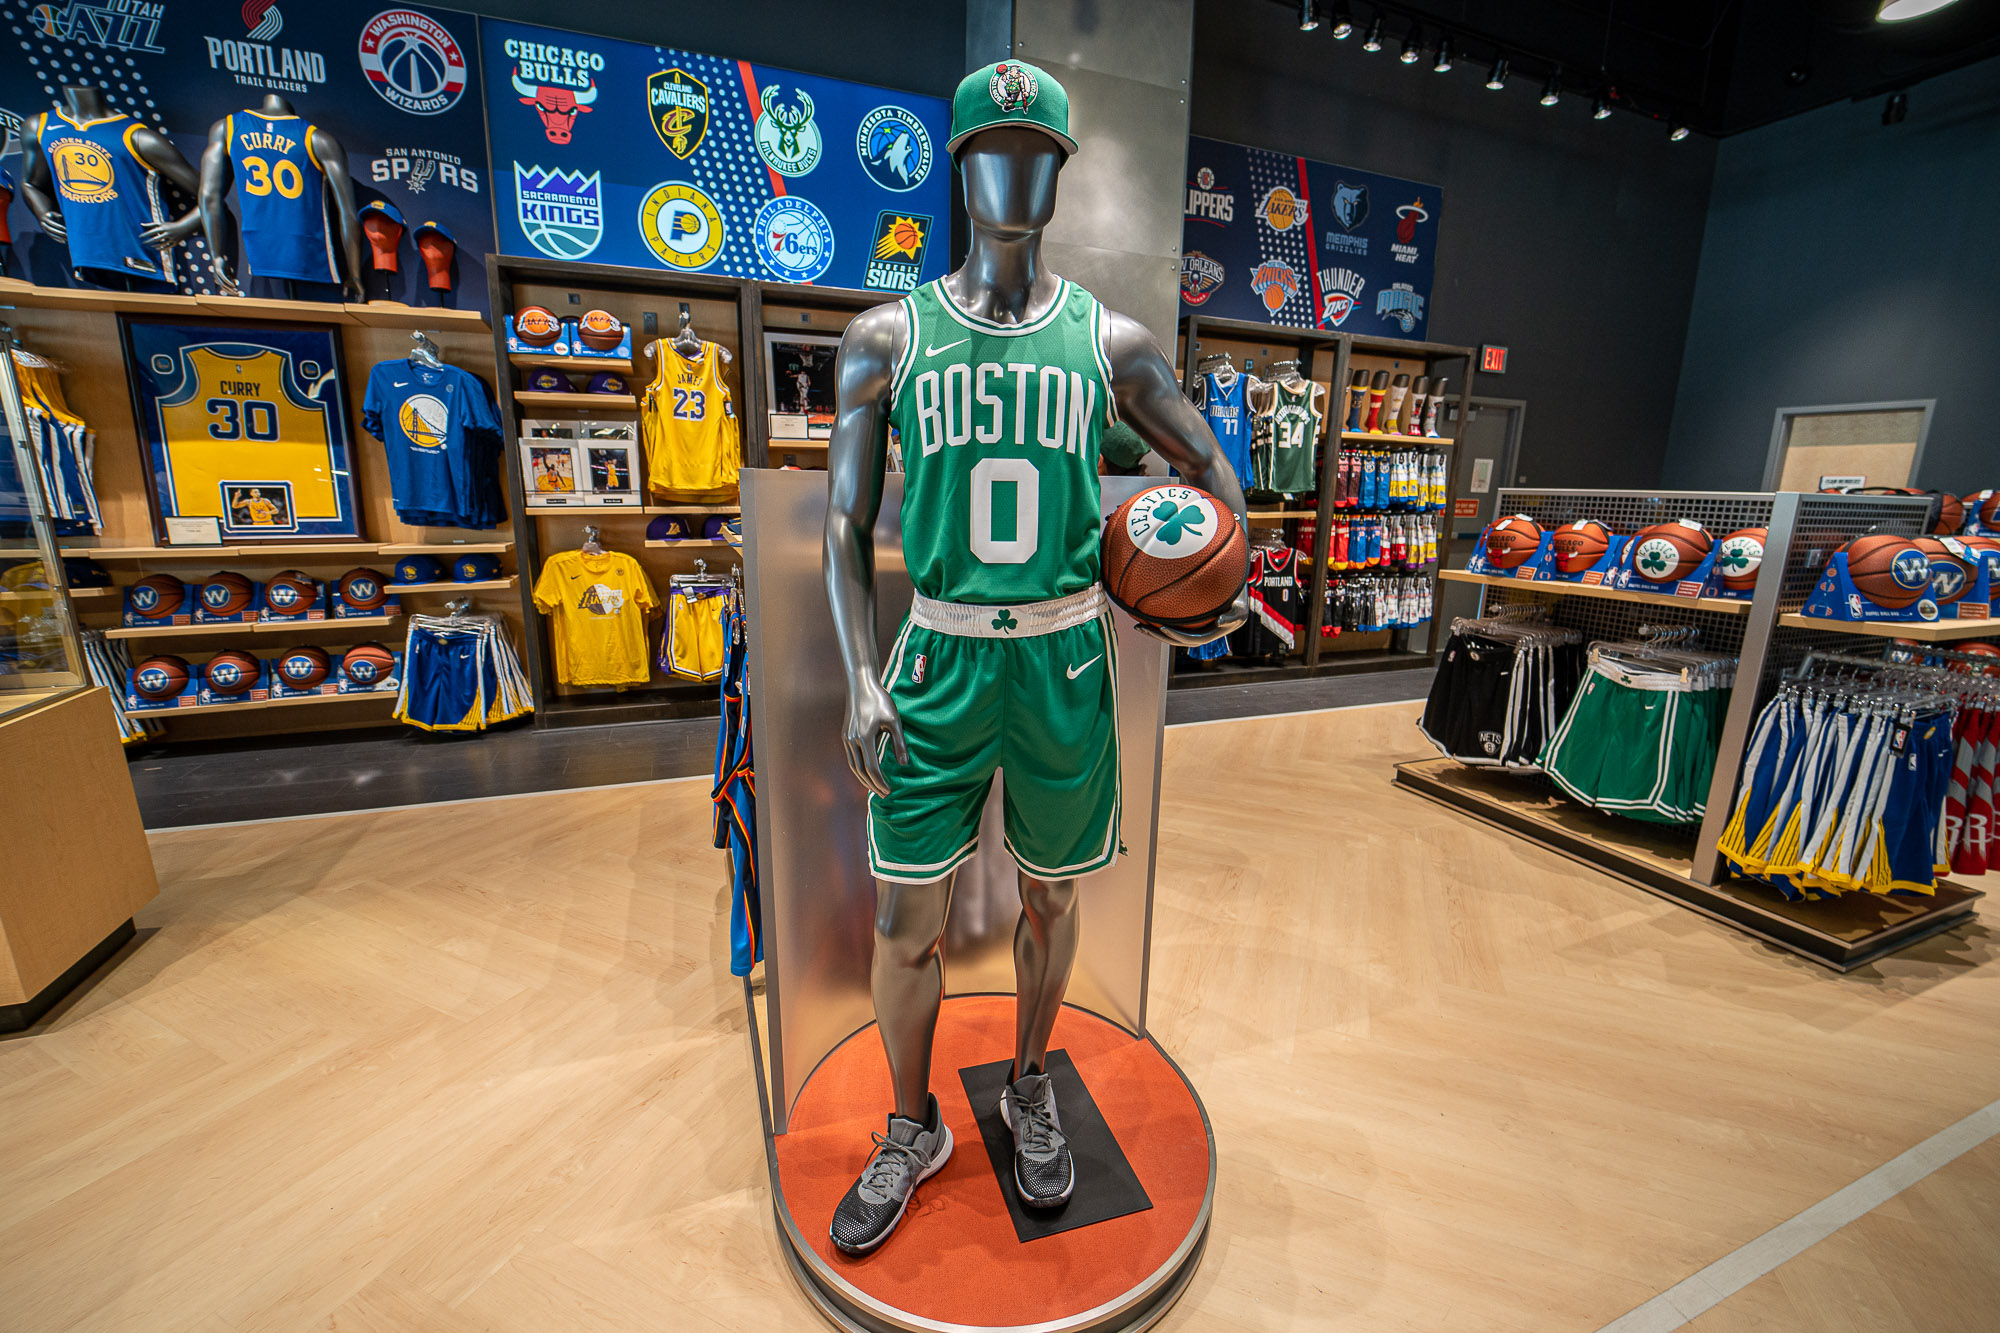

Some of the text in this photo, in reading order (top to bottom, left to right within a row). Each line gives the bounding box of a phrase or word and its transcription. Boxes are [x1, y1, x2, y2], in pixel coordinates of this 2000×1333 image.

[116, 0, 165, 18] UTAH
[369, 13, 452, 48] WASHINGTON
[203, 36, 326, 83] PORTLAND
[504, 38, 605, 72] CHICAGO
[234, 74, 308, 93] TRAIL BLAZERS
[519, 59, 590, 88] BULLS
[384, 86, 449, 111] WIZARDS
[663, 81, 693, 94] CLEVELAND
[650, 87, 706, 114] CAVALIERS
[0, 112, 21, 132] ETS
[48, 137, 113, 159] GOLDEN STATE
[240, 132, 297, 155] CURRY
[860, 109, 930, 182] MINNESOTA TIMBERWOLVES
[74, 152, 99, 167] 30
[385, 147, 461, 165] SAN ANTONIO
[797, 148, 818, 171] BUCKS
[241, 156, 304, 200] 30
[371, 158, 479, 194] SPURS
[60, 184, 119, 204] WARRIORS
[522, 189, 597, 206] SACRAMENTO
[522, 202, 599, 226] KINGS
[646, 187, 716, 224] INDIANA
[1260, 194, 1306, 222] LAKERS
[757, 199, 832, 244] PHILADELPHIA
[650, 236, 716, 266] PACERS
[772, 231, 819, 256] 76ers
[1325, 231, 1369, 249] MEMPHIS
[1325, 243, 1368, 256] GRIZZLIES
[1390, 243, 1418, 255] MIAMI
[870, 261, 920, 274] PHOENIX
[1395, 252, 1419, 264] HEAT
[865, 268, 919, 291] SUNS
[1189, 258, 1224, 282] ORLEANS
[1252, 265, 1298, 291] KNICKS
[1316, 267, 1366, 299] THUNDER
[1322, 299, 1348, 319] OKC
[1376, 288, 1424, 321] MAGIC
[1483, 346, 1506, 371] EXIT
[220, 380, 261, 397] CURRY
[677, 373, 703, 386] JAMES
[672, 386, 706, 422] 23
[915, 362, 1096, 462] BOSTON
[206, 397, 281, 443] 30
[1222, 418, 1238, 436] 77
[1278, 421, 1305, 448] 34
[969, 457, 1040, 564] 0
[1131, 488, 1192, 537] CELTICS
[1638, 538, 1676, 560] CELTICS
[352, 583, 373, 597] W
[1263, 576, 1294, 587] PORTLAND
[132, 590, 154, 606] W
[204, 589, 226, 604] W
[272, 588, 297, 603] W
[1282, 588, 1289, 602] 0
[213, 668, 237, 683] W
[286, 660, 311, 675] W
[352, 666, 373, 679] W
[140, 673, 165, 688] W
[1480, 732, 1502, 745] NETS
